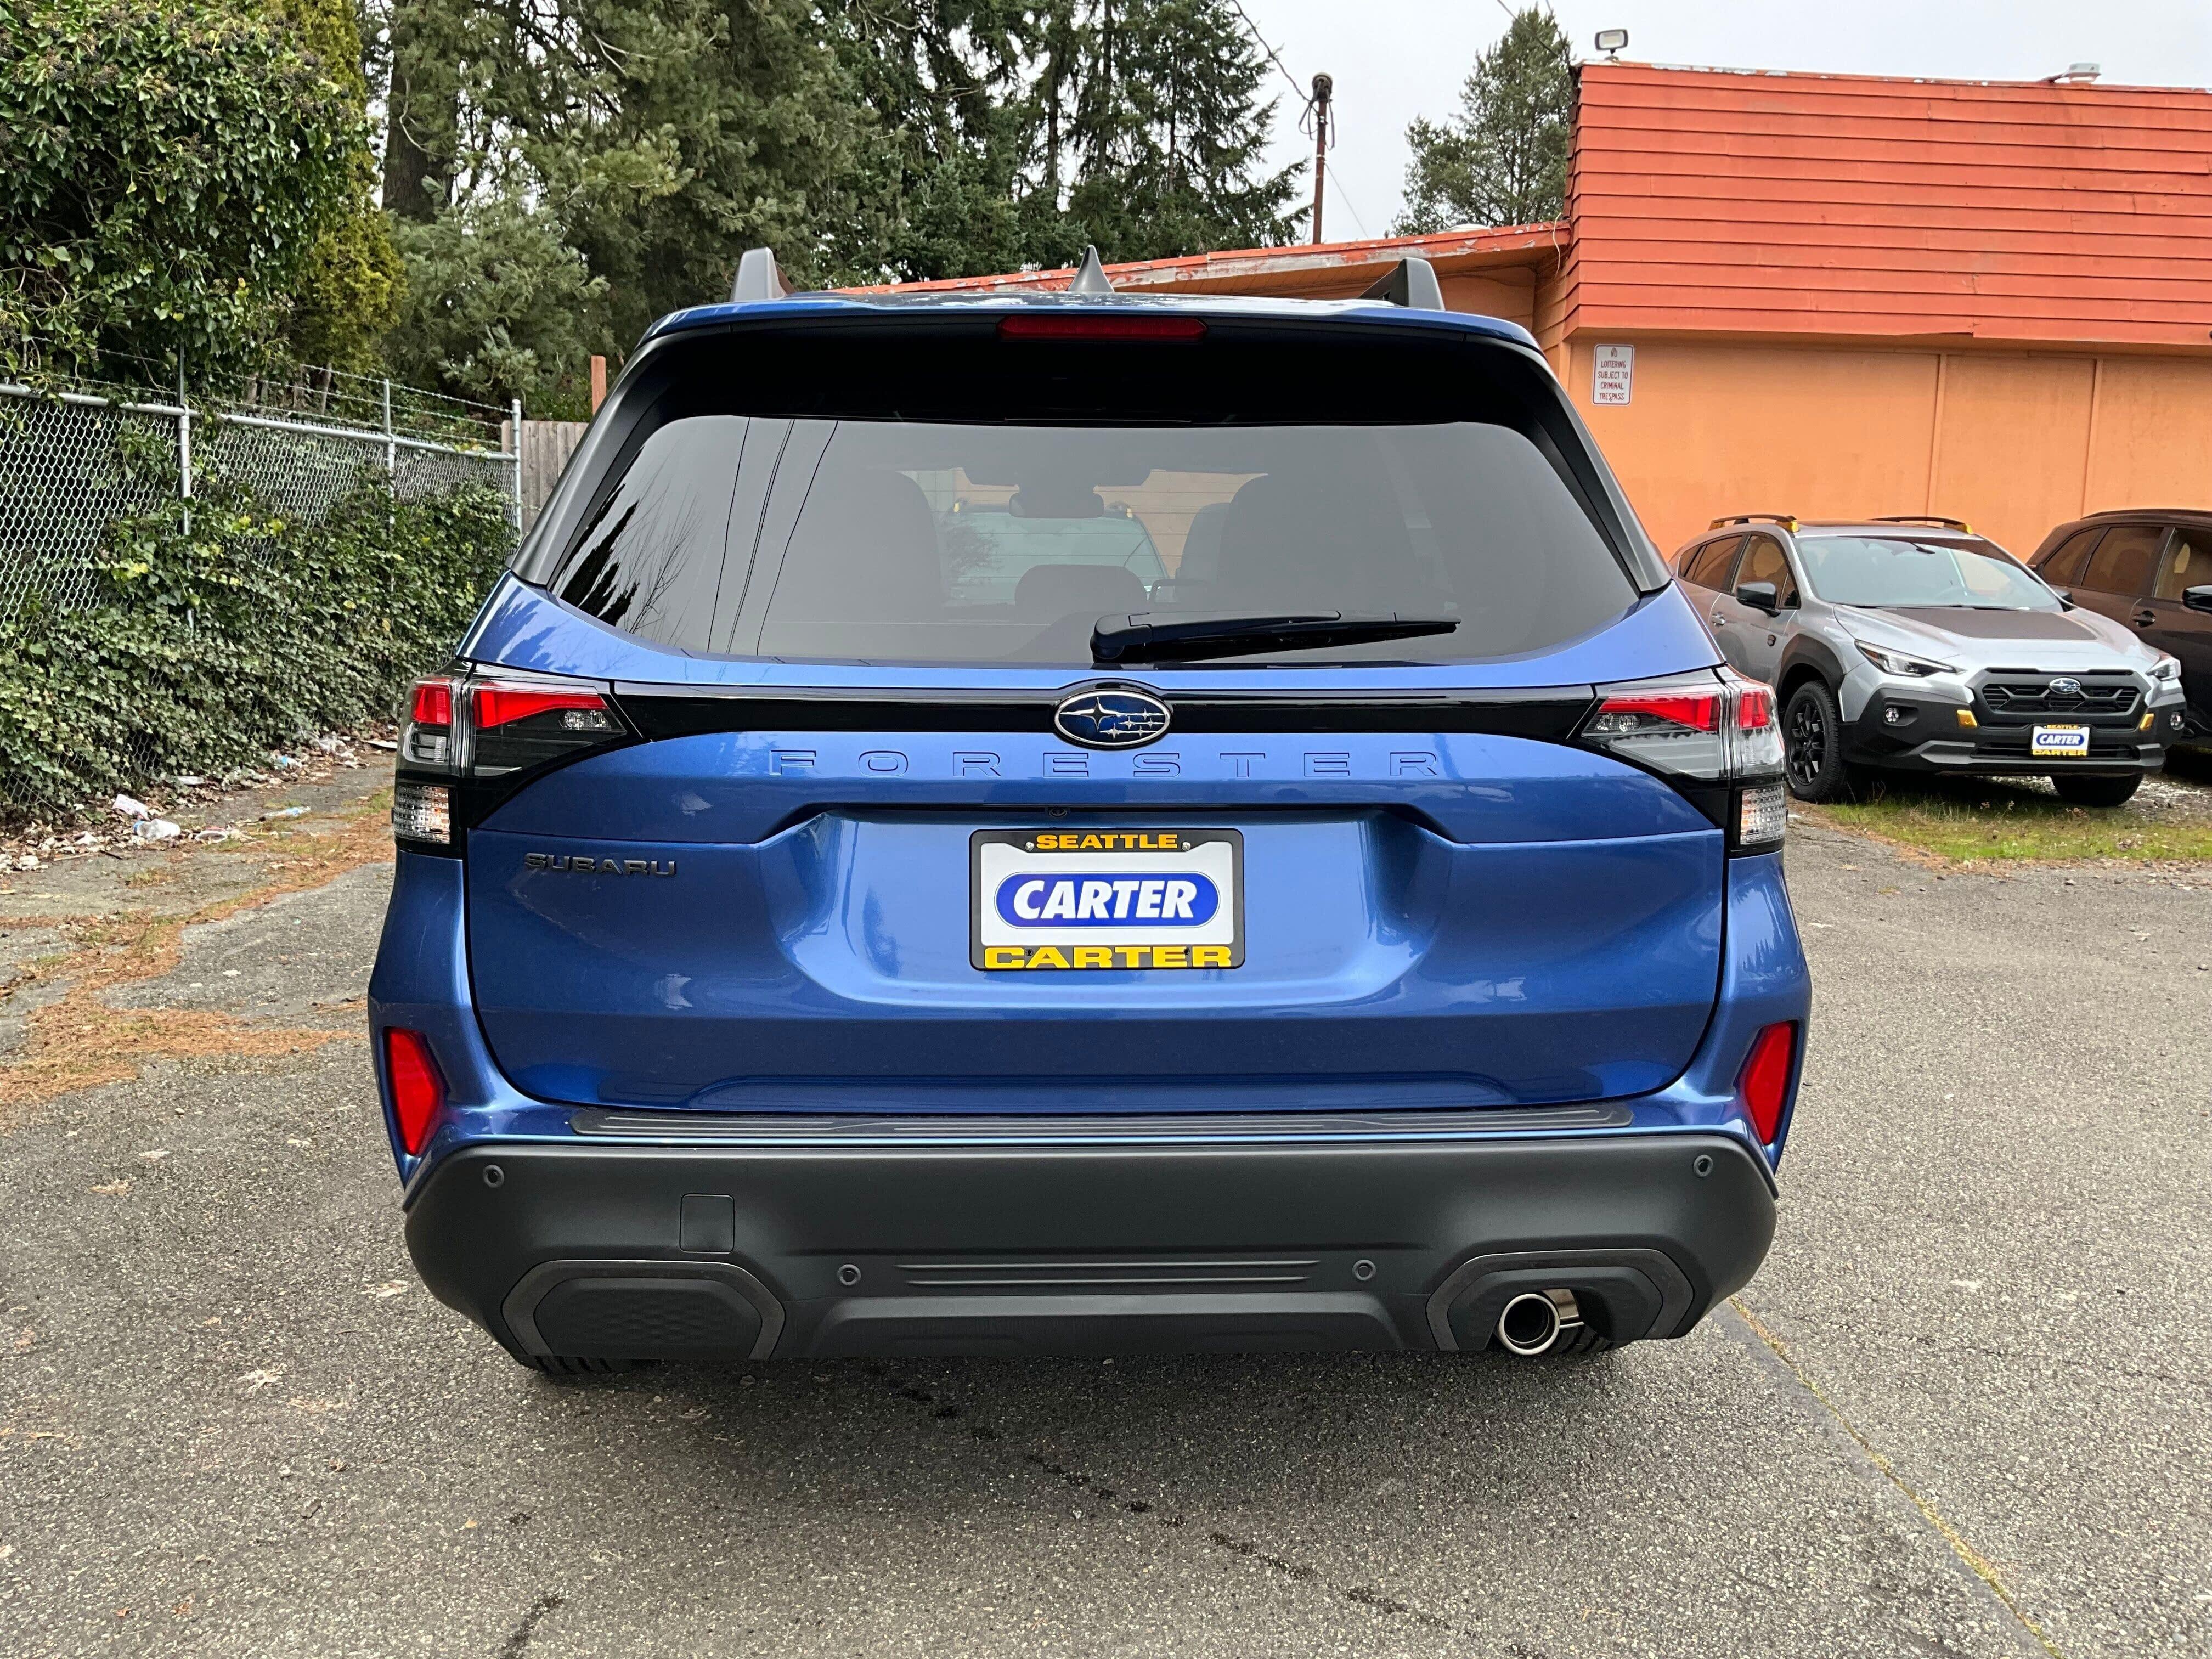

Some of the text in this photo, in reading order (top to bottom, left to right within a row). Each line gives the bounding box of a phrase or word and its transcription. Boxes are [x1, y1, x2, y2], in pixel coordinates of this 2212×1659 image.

[1598, 371, 1620, 379] SUBJECT
[1599, 392, 1624, 400] TRESPASS
[2039, 735, 2081, 744] CARTER
[769, 750, 1438, 776] FORESTER
[1036, 834, 1178, 849] SEATTLE
[524, 853, 678, 876] SUBARU
[1013, 879, 1198, 919] CARTER
[984, 946, 1232, 969] CARTER
